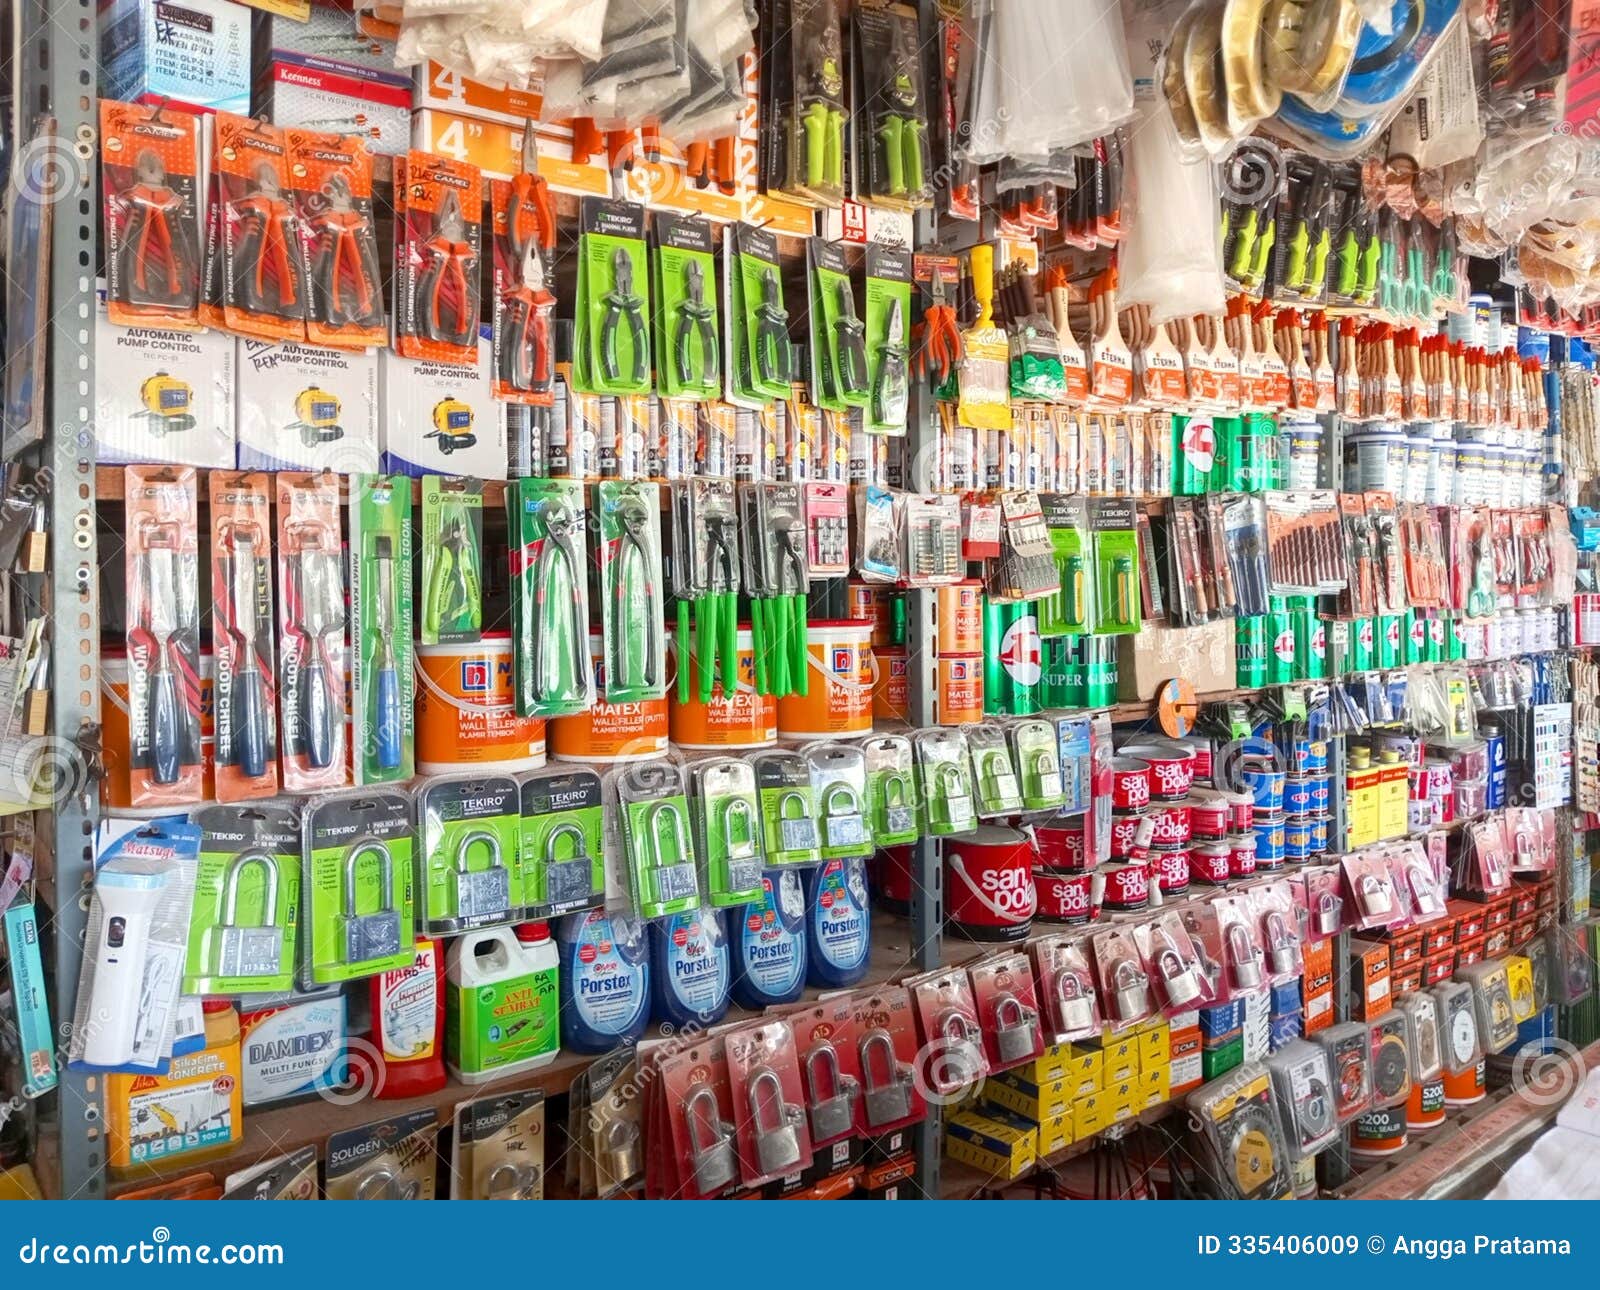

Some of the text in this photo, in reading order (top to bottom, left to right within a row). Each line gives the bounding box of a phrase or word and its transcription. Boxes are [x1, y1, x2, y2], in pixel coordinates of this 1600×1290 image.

[280, 68, 322, 87] Keenness
[134, 126, 178, 138] CAMEL
[245, 138, 282, 154] CAMEL
[315, 152, 352, 164] CAMEL
[433, 173, 469, 188] CAMEL
[607, 215, 633, 224] TEKIRO
[678, 229, 702, 239] TEKIRO
[495, 269, 503, 294] PLIER
[408, 265, 416, 322] COMBINATION
[494, 294, 502, 355] COMBINATION
[127, 328, 192, 342] AUTOMATIC
[117, 338, 202, 353] PUMP CONTROL
[282, 345, 342, 358] AUTOMATIC
[274, 354, 349, 369] PUMP CONTROL
[414, 367, 480, 380] PUMP CONTROL
[1052, 507, 1080, 515] TEKIRO
[1101, 509, 1131, 518] TEKIRO
[352, 587, 360, 615] KAYU
[401, 518, 412, 737] WOOD CHISEL WITH FIBER HANDLE
[221, 645, 230, 698] WOOD
[1042, 673, 1083, 686] SUPER
[137, 644, 149, 756] WOOD CHISEL
[592, 702, 641, 715] MATEX
[708, 708, 729, 717] WALL
[459, 719, 516, 731] WALL FILLER
[592, 713, 644, 725] WALL FILLER
[458, 729, 515, 739] PLAMIR TEMBOK
[592, 725, 643, 734] PLAMIR TEMBOK
[1155, 764, 1181, 777] san
[1121, 775, 1146, 790] san
[462, 797, 503, 809] TEKIRO
[550, 791, 588, 802] TEKIRO
[211, 831, 244, 841] TEKIRO
[326, 825, 357, 836] TEKIRO
[122, 840, 177, 860] Matsugi
[1162, 856, 1186, 871] san
[982, 868, 1026, 890] san
[1116, 871, 1142, 884] san
[1053, 884, 1083, 898] san
[822, 918, 861, 936] Porstex
[750, 941, 793, 960] Porstex
[676, 956, 719, 977] Porstex
[581, 974, 631, 995] Porstex
[504, 988, 533, 1004] ANTI
[493, 997, 541, 1017] SUMBAT
[250, 1030, 334, 1064] DAMDEX
[167, 1061, 226, 1081] CONCRETE
[260, 1064, 290, 1077] MULTI
[476, 1113, 509, 1128] SOLIGEN
[331, 1140, 380, 1162] SOLIGEN
